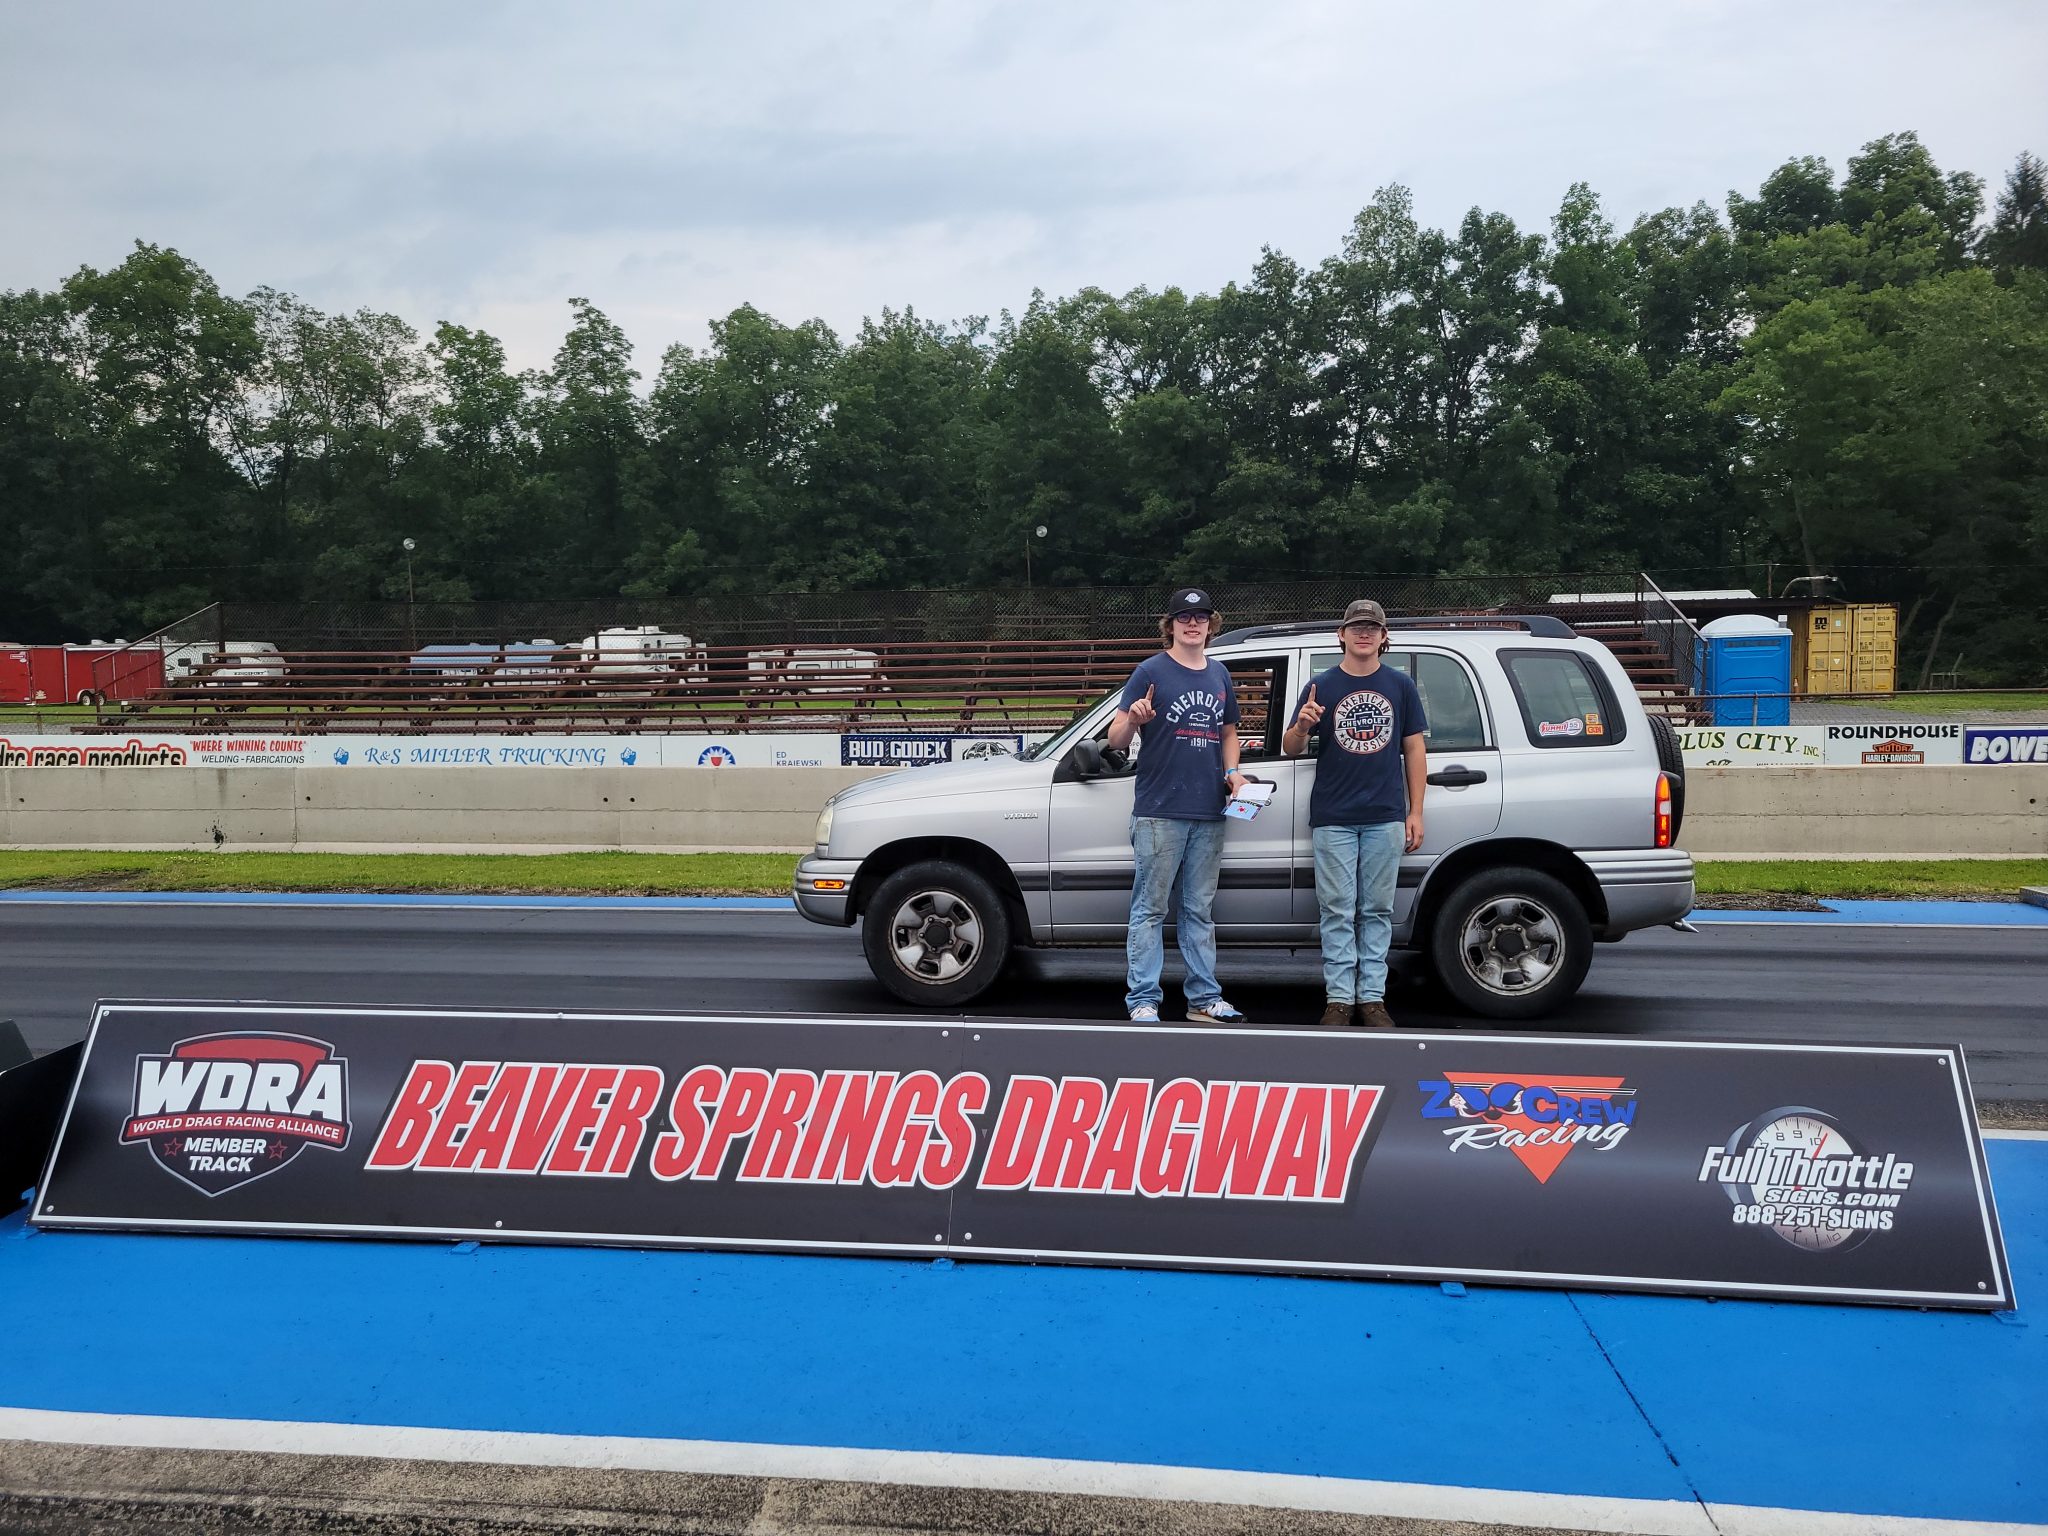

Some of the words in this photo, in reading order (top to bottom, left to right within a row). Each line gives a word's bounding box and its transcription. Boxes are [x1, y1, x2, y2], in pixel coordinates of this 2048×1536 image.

[1337, 693, 1391, 717] AMERICAN
[1341, 718, 1387, 728] CHEVROLET
[1828, 725, 1959, 739] ROUNDHOUSE
[226, 740, 266, 752] WINNING
[849, 740, 884, 758] BUD
[890, 741, 948, 758] GODEK
[1342, 735, 1387, 751] CLASSIC
[1736, 731, 1799, 753] CITY
[1878, 743, 1910, 752] MOTOR
[34, 752, 79, 766] race
[364, 747, 401, 766] R&S
[410, 747, 494, 766] MILLER
[499, 747, 606, 767] TRUCKING
[776, 751, 787, 759] ED
[1865, 754, 1921, 763] HARLEY-DAVIDSON
[1004, 812, 1038, 820] VITARA
[138, 1060, 343, 1122] WDRA
[133, 1118, 182, 1133] WORLD
[185, 1116, 223, 1128] DRAG
[225, 1116, 275, 1129] RACING
[277, 1119, 340, 1139] ALLIANCE
[364, 1060, 664, 1178] BEAVER
[650, 1065, 990, 1188] SPRINGS
[976, 1075, 1386, 1203] DRAGWAY
[1442, 1118, 1630, 1153] Racing
[184, 1137, 267, 1154] MEMBER
[189, 1156, 253, 1172] TRACK
[1765, 1188, 1901, 1208] SIGNS.COM
[1732, 1204, 1894, 1231] 888-251-SIGNS
